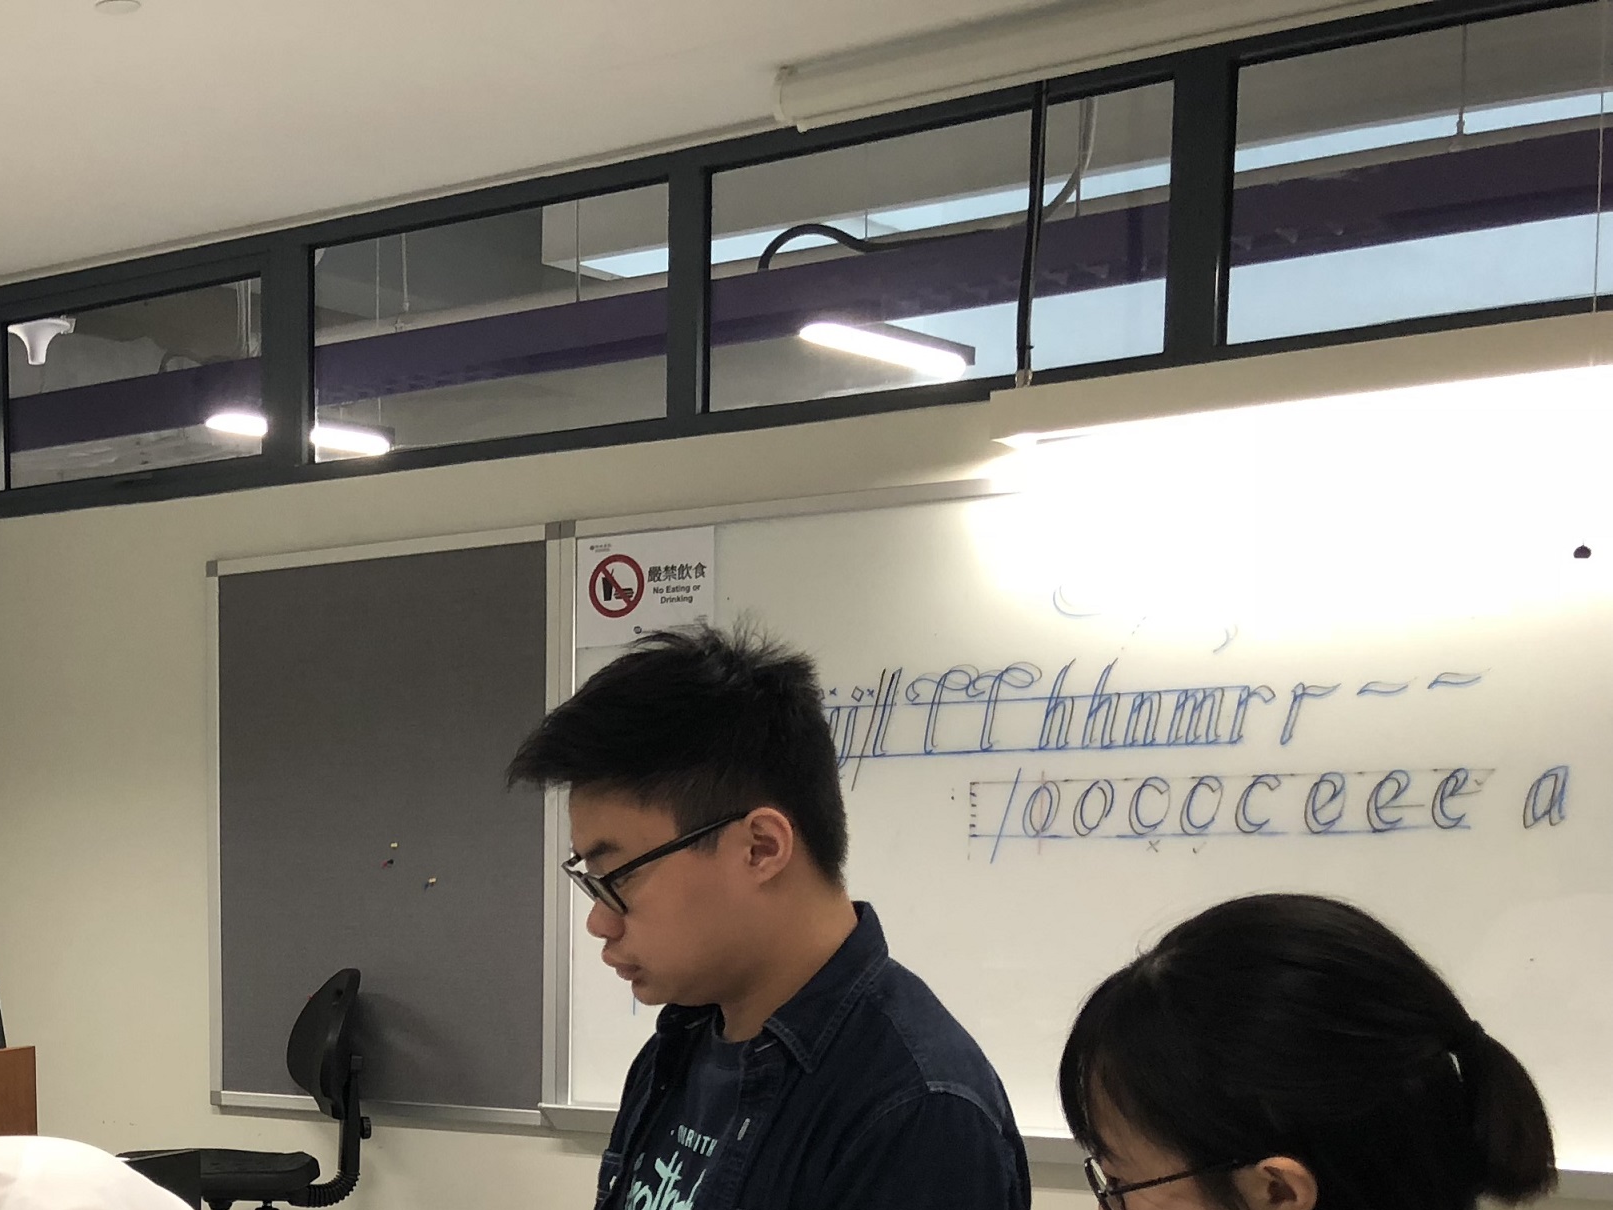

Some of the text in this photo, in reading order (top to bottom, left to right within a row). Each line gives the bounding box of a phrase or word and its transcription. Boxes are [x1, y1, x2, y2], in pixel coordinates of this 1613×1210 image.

[647, 561, 707, 583] 嚴禁飲食
[653, 584, 701, 595] No Eating or
[660, 594, 694, 605] Drinking
